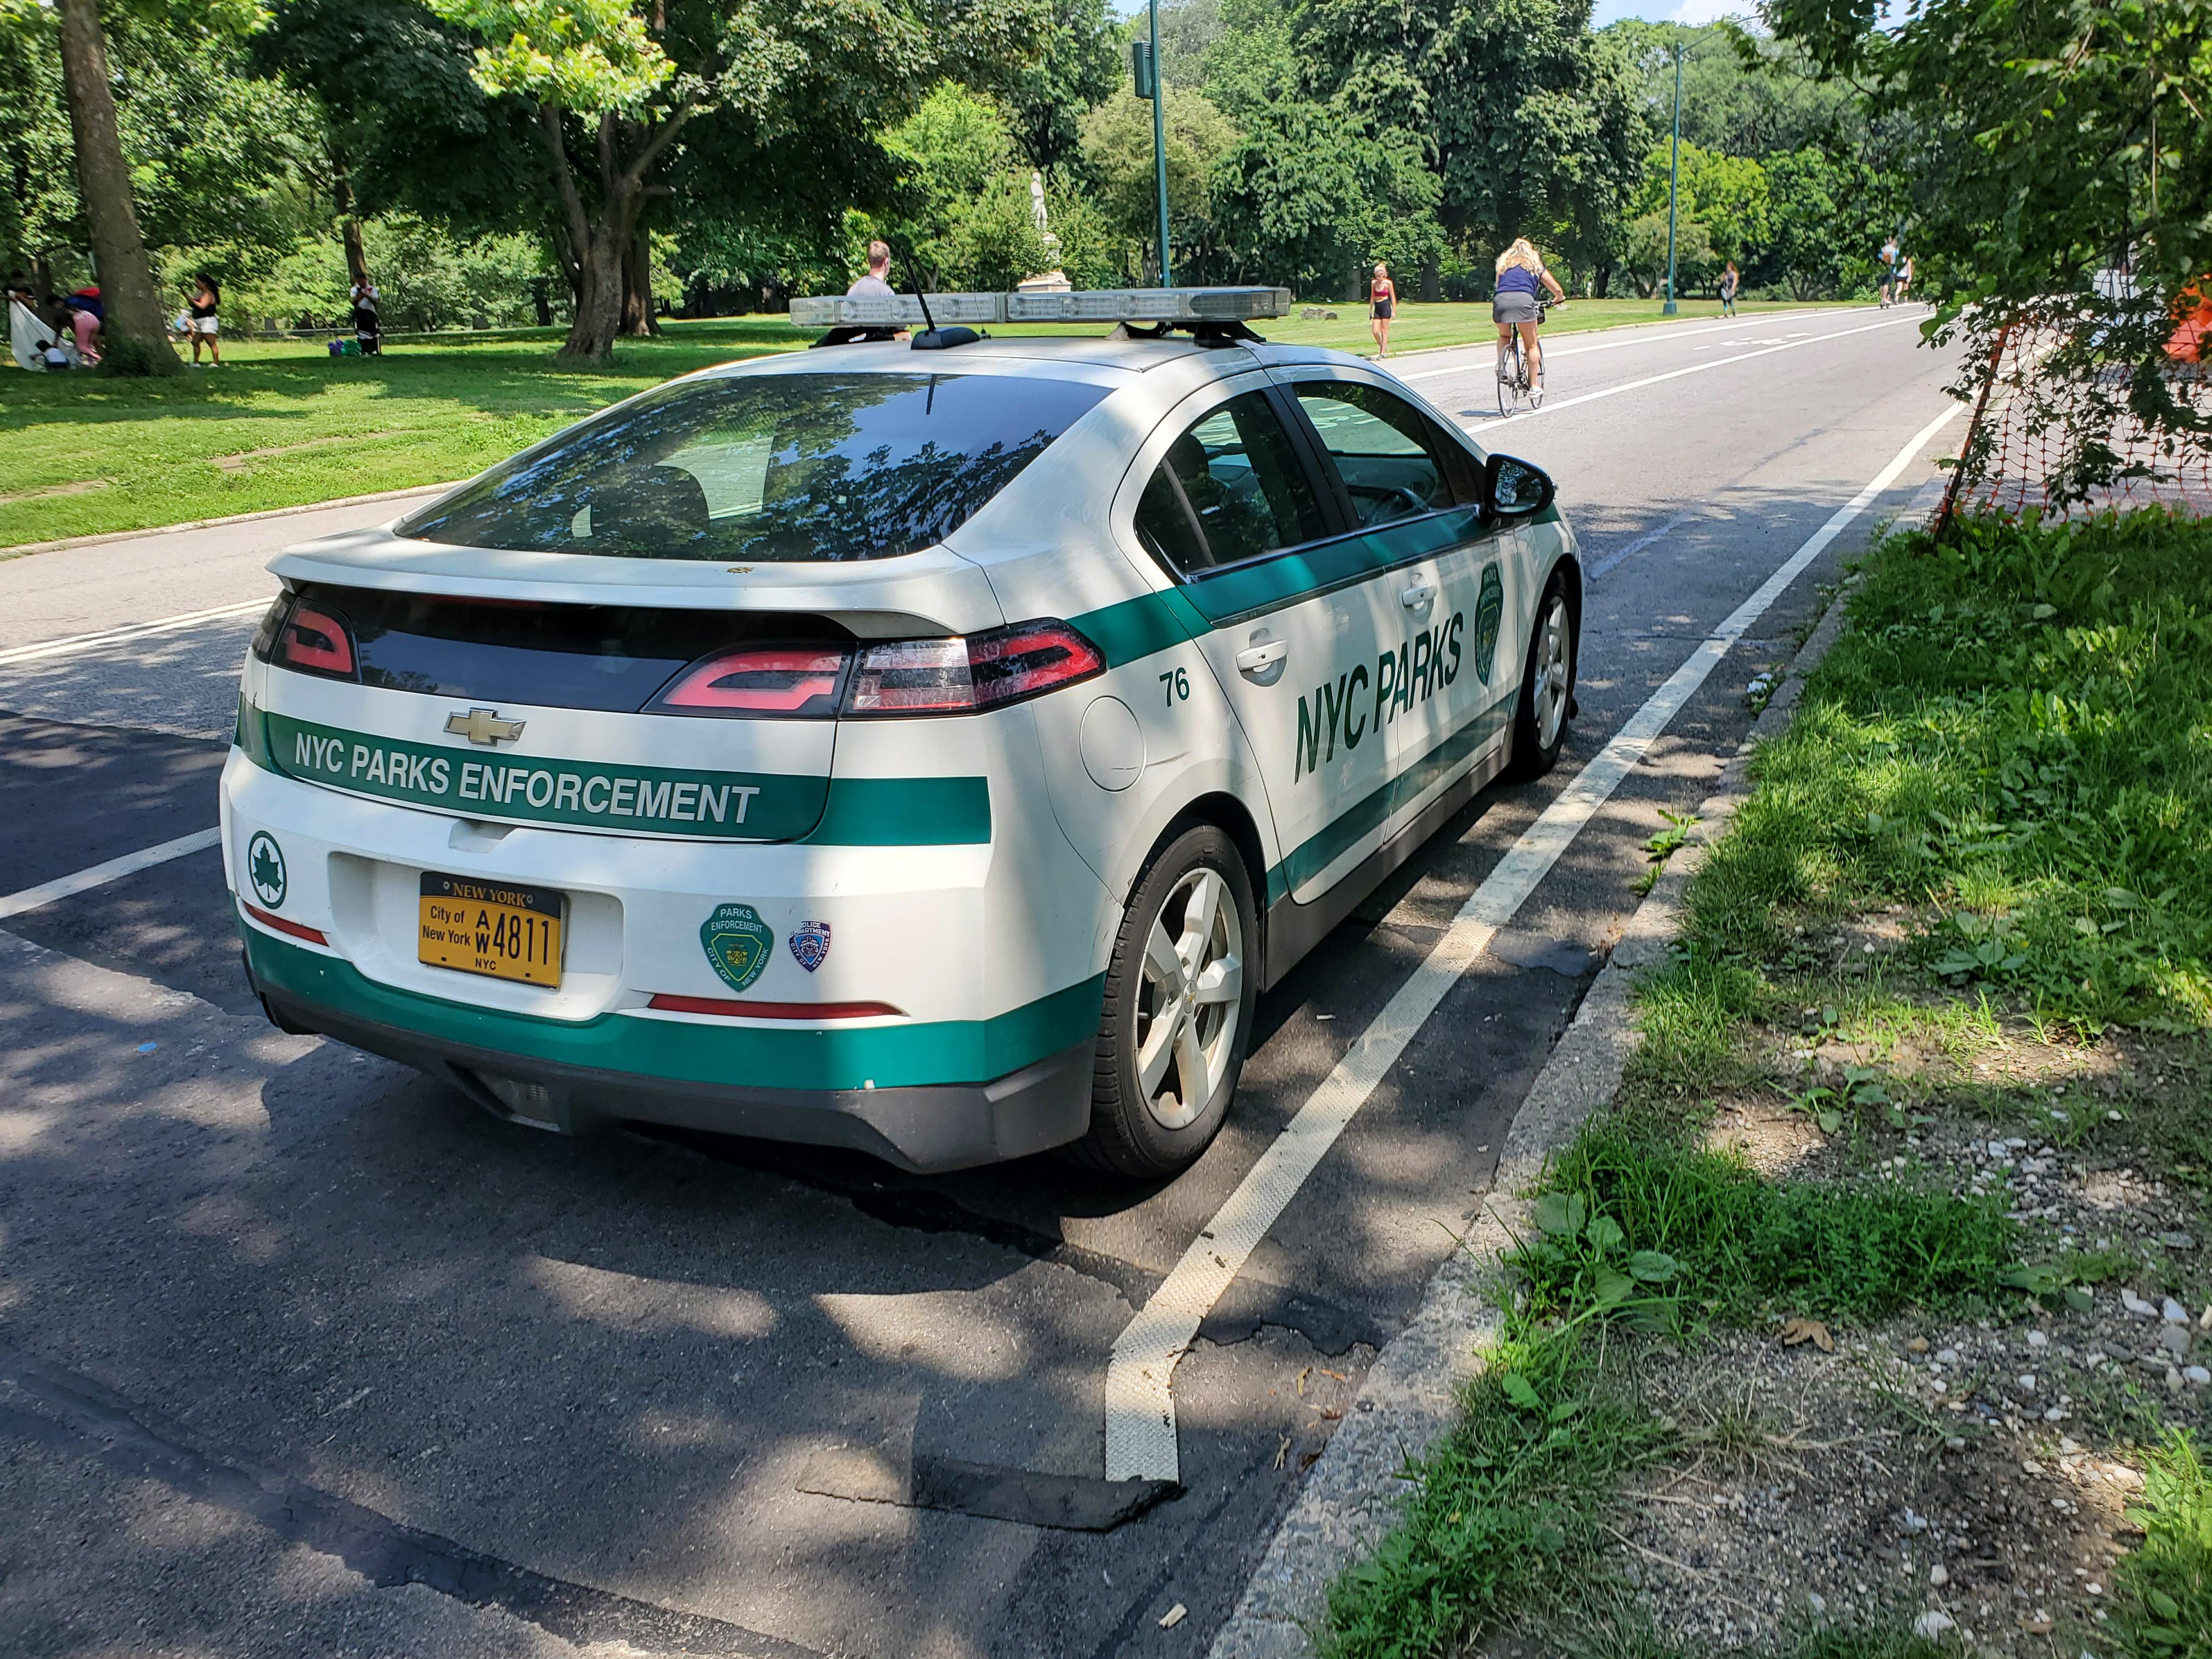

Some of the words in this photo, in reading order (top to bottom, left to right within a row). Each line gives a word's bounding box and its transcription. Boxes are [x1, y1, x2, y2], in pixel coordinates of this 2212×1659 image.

[1159, 667, 1190, 707] 76
[1294, 664, 1368, 786] NYC
[1373, 612, 1464, 735] PARKS
[295, 732, 345, 773] NYC
[351, 744, 450, 794] PARKS
[459, 762, 760, 823] ENFORCEMENT
[453, 883, 487, 899] NEW
[489, 888, 527, 907] YORK
[431, 906, 451, 924] City
[454, 910, 465, 924] of
[476, 909, 490, 930] A
[720, 908, 752, 919] PARKS
[422, 924, 445, 941] New
[448, 929, 471, 946] York
[711, 920, 763, 933] ENFORCEMENT
[792, 928, 830, 938] EARTMENT
[475, 932, 490, 954] W
[493, 912, 549, 966] 4811
[791, 943, 800, 957] CITY
[475, 957, 497, 970] NYC
[707, 947, 722, 968] CITY
[720, 969, 732, 981] OF
[812, 956, 823, 968] NEW
[821, 938, 830, 953] YORK
[742, 970, 757, 986] NEW
[754, 947, 769, 969] YORK
